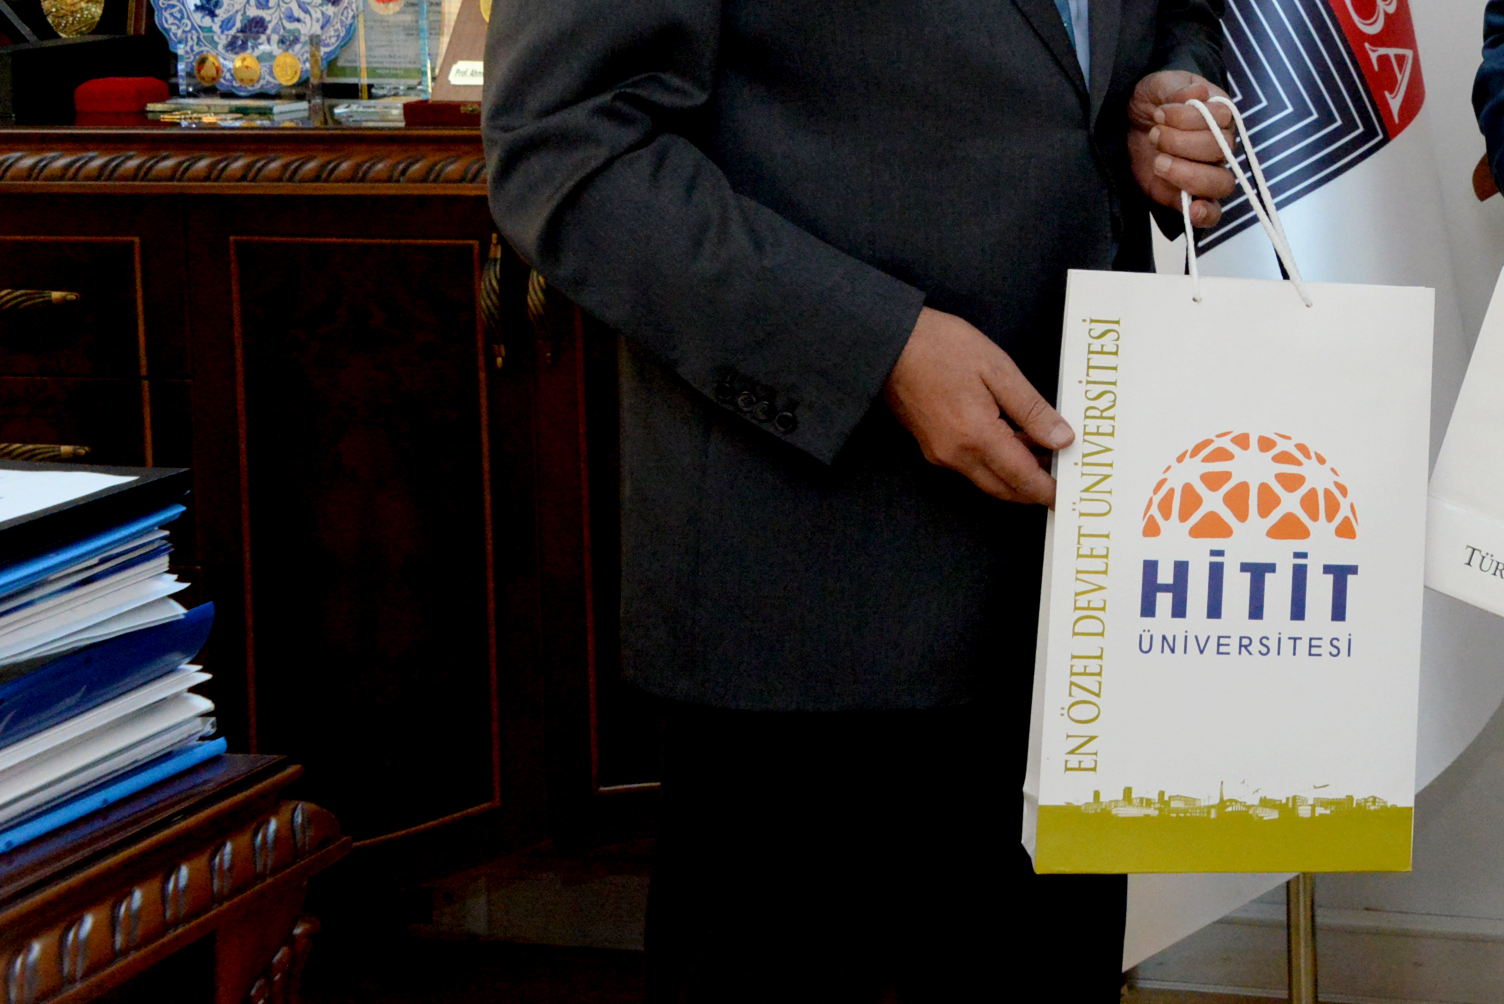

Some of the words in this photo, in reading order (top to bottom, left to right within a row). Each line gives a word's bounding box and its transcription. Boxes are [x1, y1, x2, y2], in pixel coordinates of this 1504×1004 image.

[1072, 317, 1121, 518] ÜNİVERSİTESİ
[1072, 525, 1111, 638] DEVLET
[1139, 549, 1359, 622] HİTİT
[1138, 629, 1353, 658] ÜNİVERSİTESİ
[1060, 647, 1105, 725] ÖZEL
[1065, 734, 1099, 773] EN
